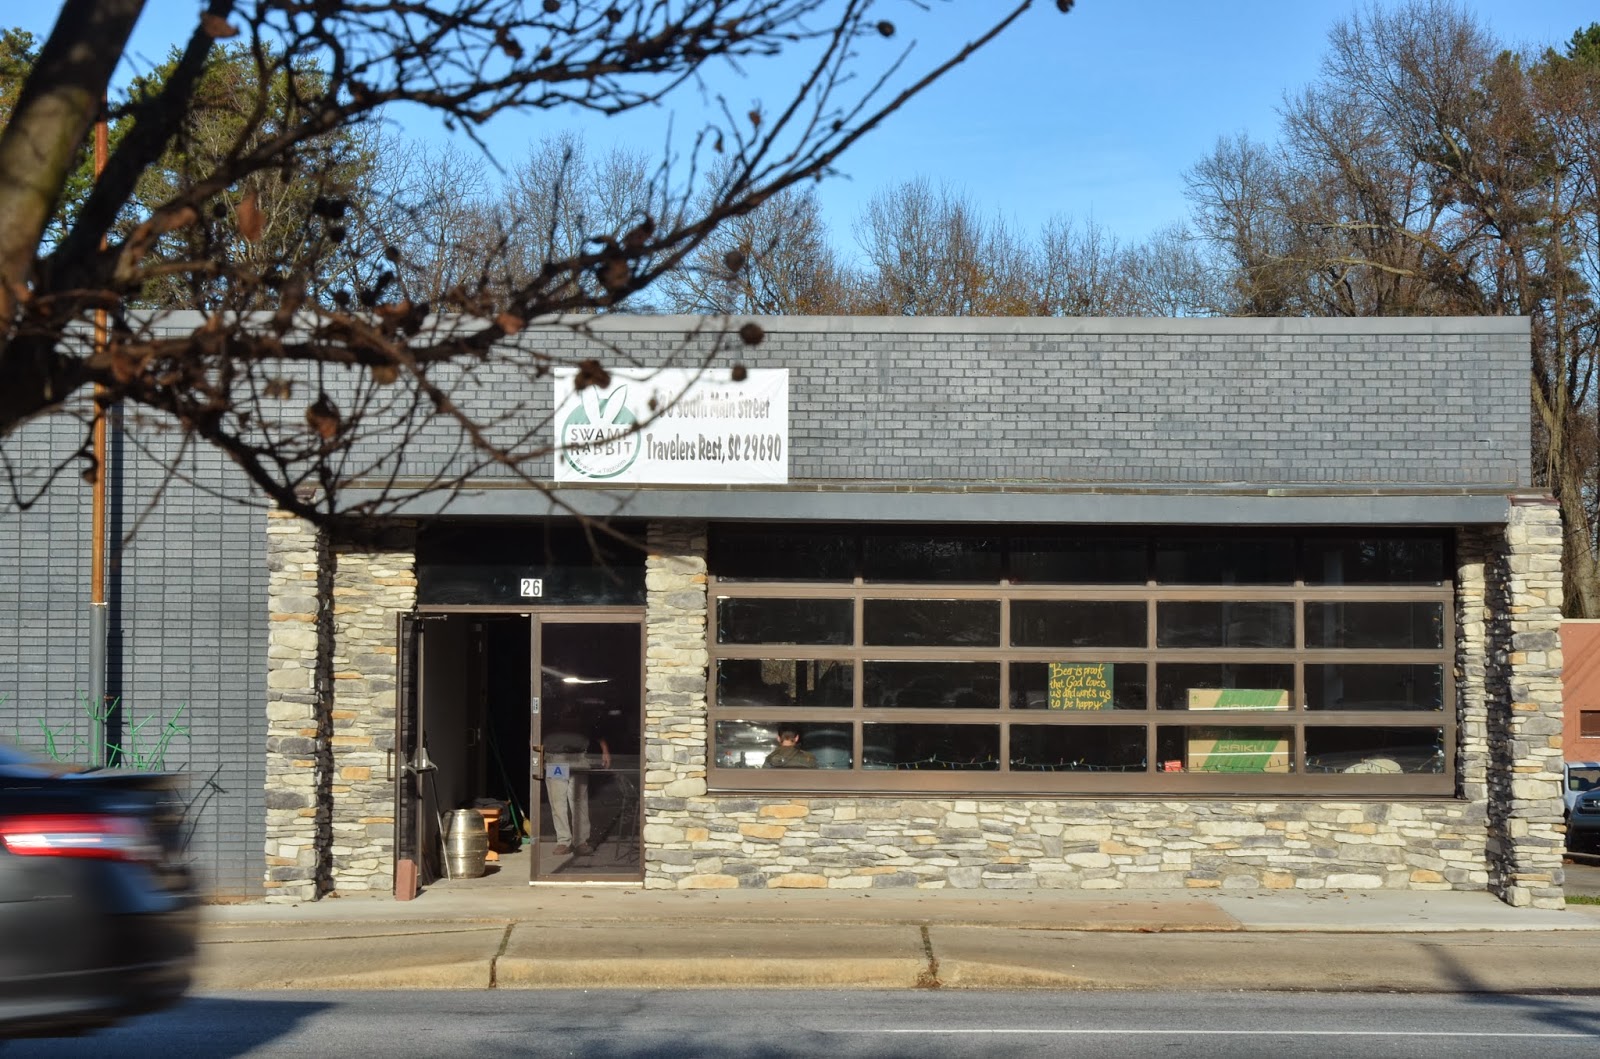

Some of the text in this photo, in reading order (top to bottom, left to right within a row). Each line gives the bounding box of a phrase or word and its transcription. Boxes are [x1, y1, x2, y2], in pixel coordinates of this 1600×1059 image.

[738, 391, 770, 418] Street
[570, 441, 632, 455] RABBIT
[646, 433, 782, 464] Travelers Rest, SC 29690
[522, 579, 541, 596] 26
[1075, 665, 1083, 676] is
[1083, 664, 1105, 679] proof
[1049, 675, 1107, 690] that God loves
[1049, 687, 1112, 699] us and wants us
[1050, 699, 1061, 708] to
[1063, 698, 1073, 710] be
[554, 766, 562, 775] A
